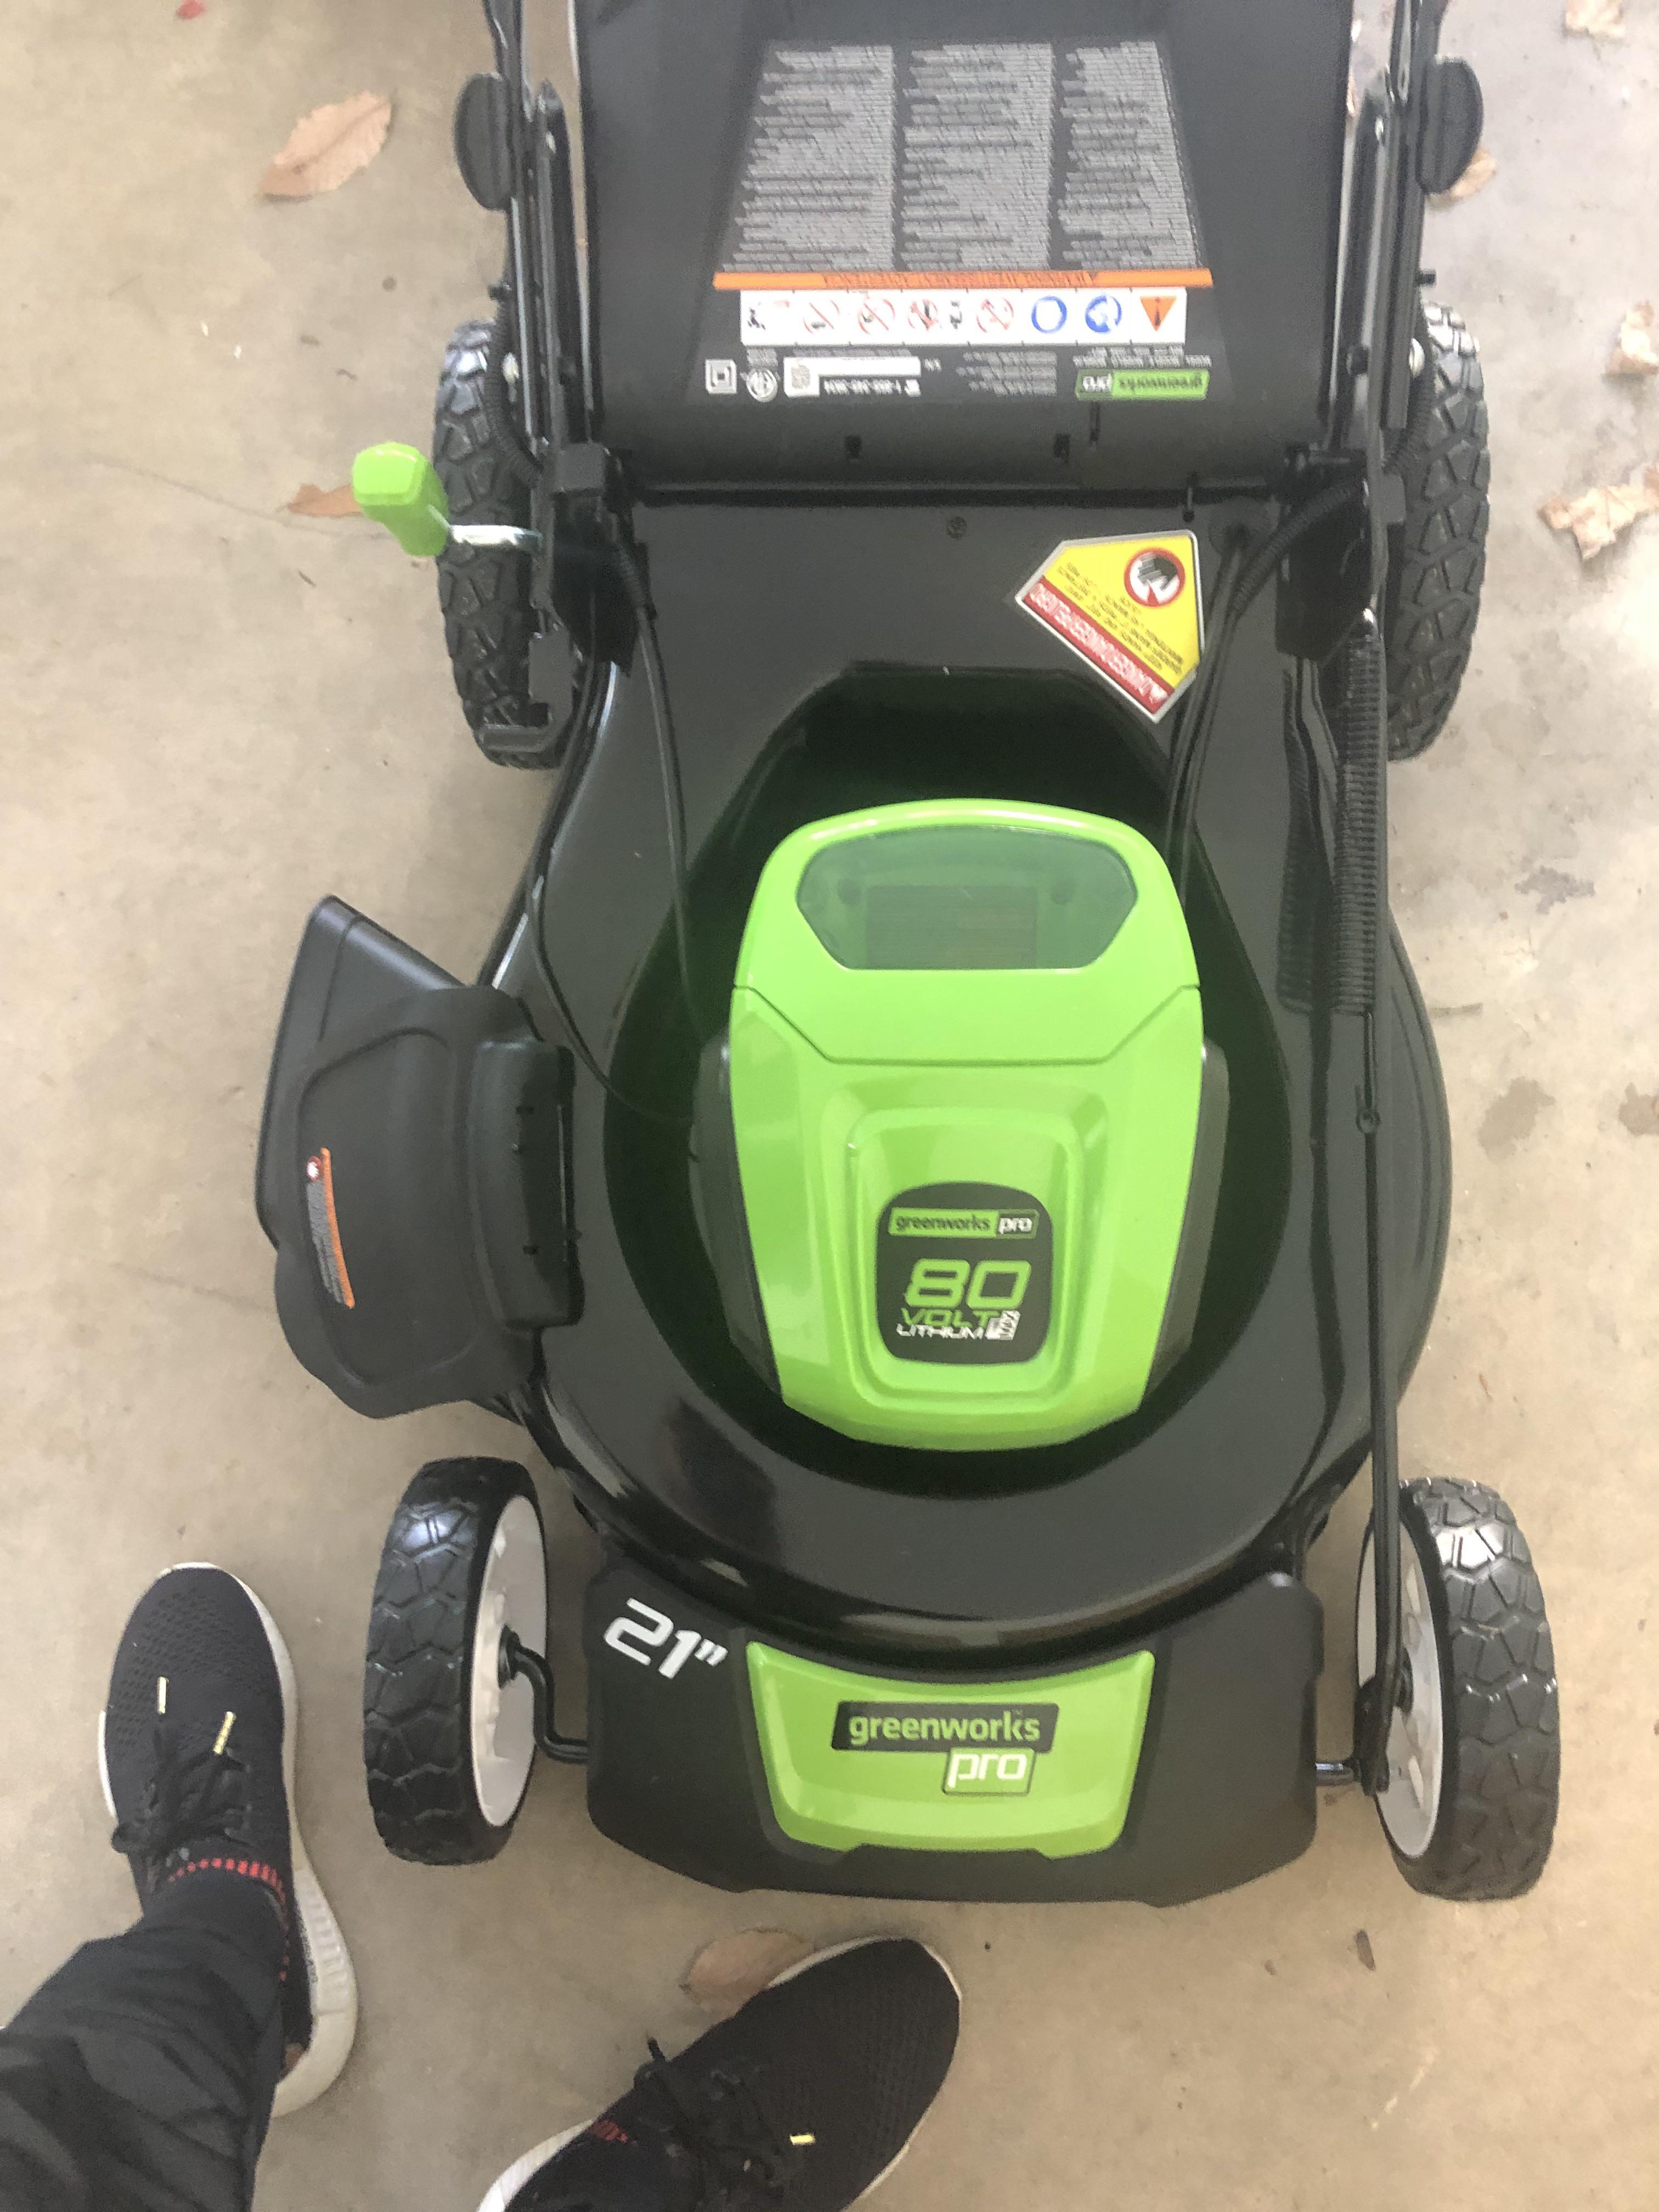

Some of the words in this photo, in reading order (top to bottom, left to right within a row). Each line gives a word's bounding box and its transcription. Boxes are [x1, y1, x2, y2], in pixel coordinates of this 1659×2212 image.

[998, 1217, 1032, 1234] pro
[905, 1258, 1031, 1309] 80
[901, 1307, 1000, 1329] VOLT
[849, 1711, 1040, 1747] greenworks
[947, 1753, 1028, 1788] pro
